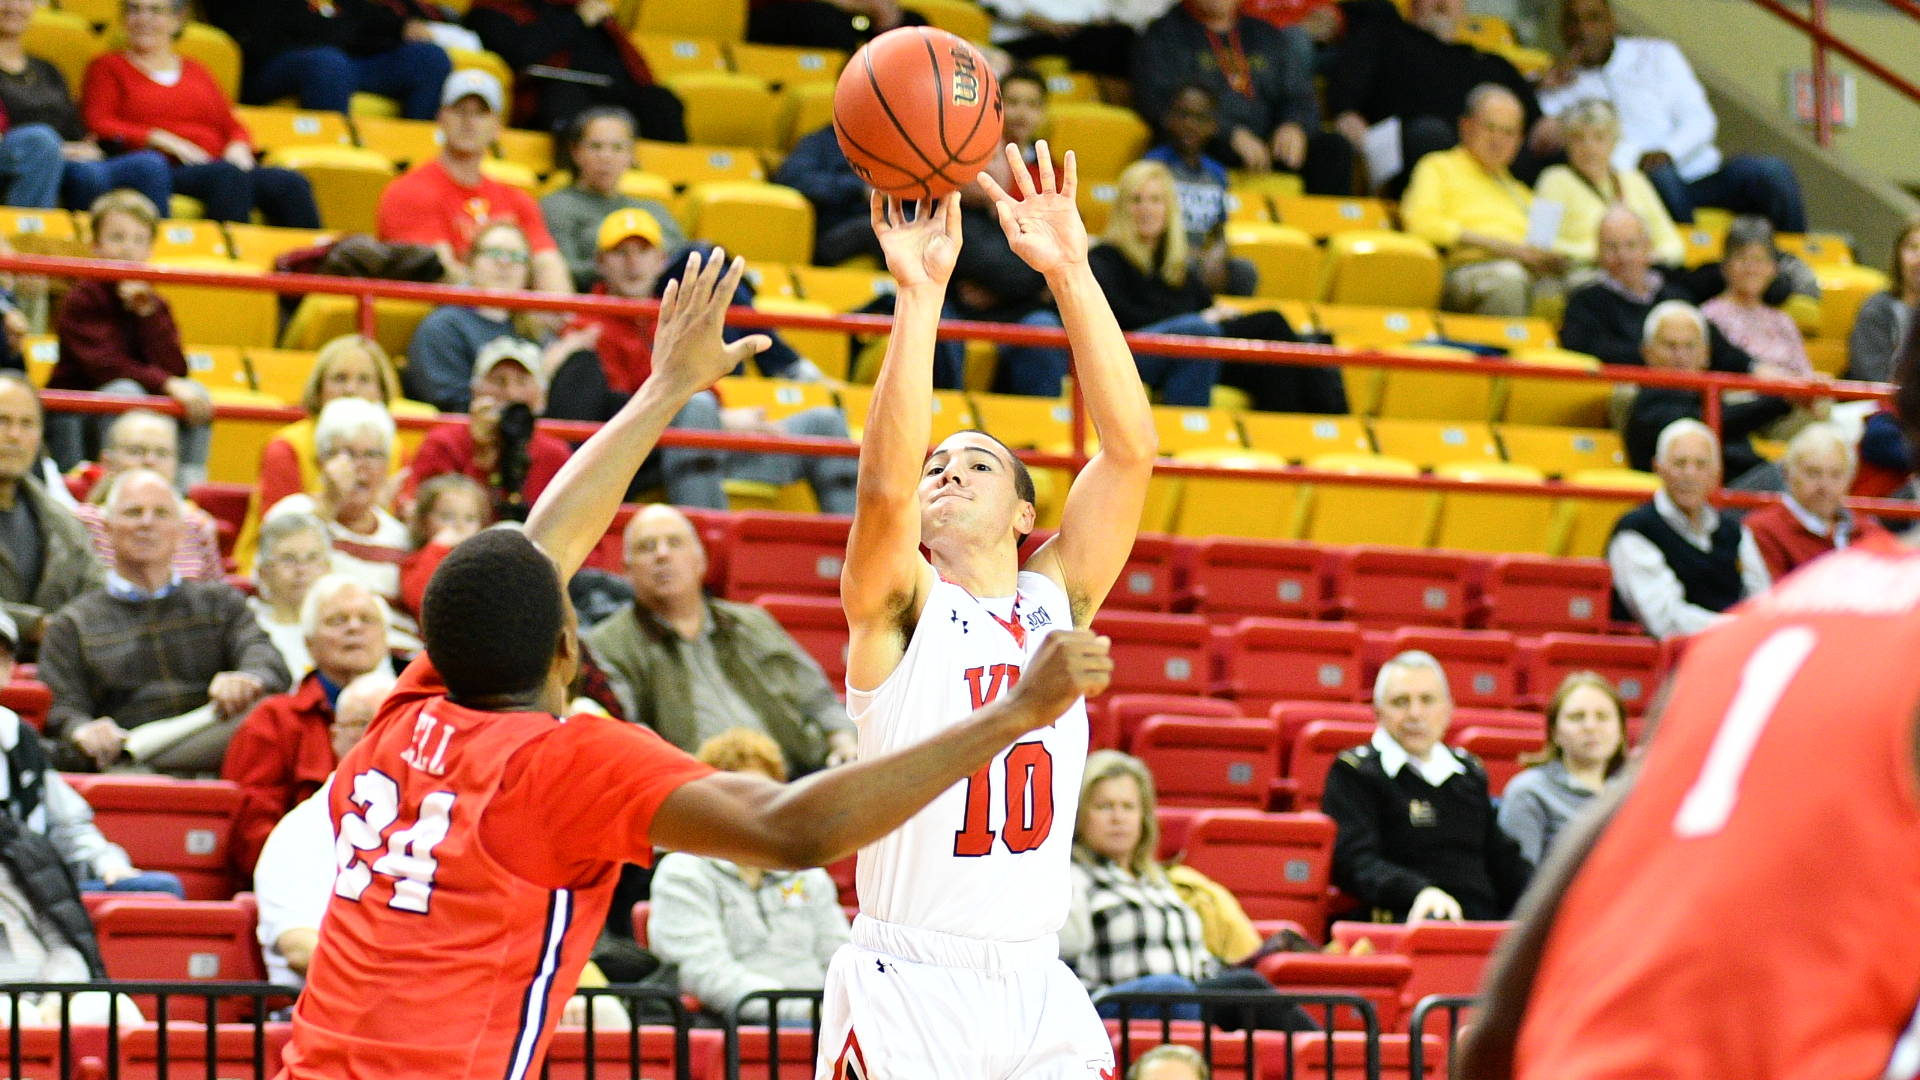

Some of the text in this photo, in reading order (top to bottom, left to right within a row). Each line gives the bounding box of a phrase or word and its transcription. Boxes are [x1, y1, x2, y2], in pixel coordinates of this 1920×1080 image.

[953, 740, 1055, 858] 10
[1672, 624, 1819, 839] 1
[334, 767, 458, 915] 24
